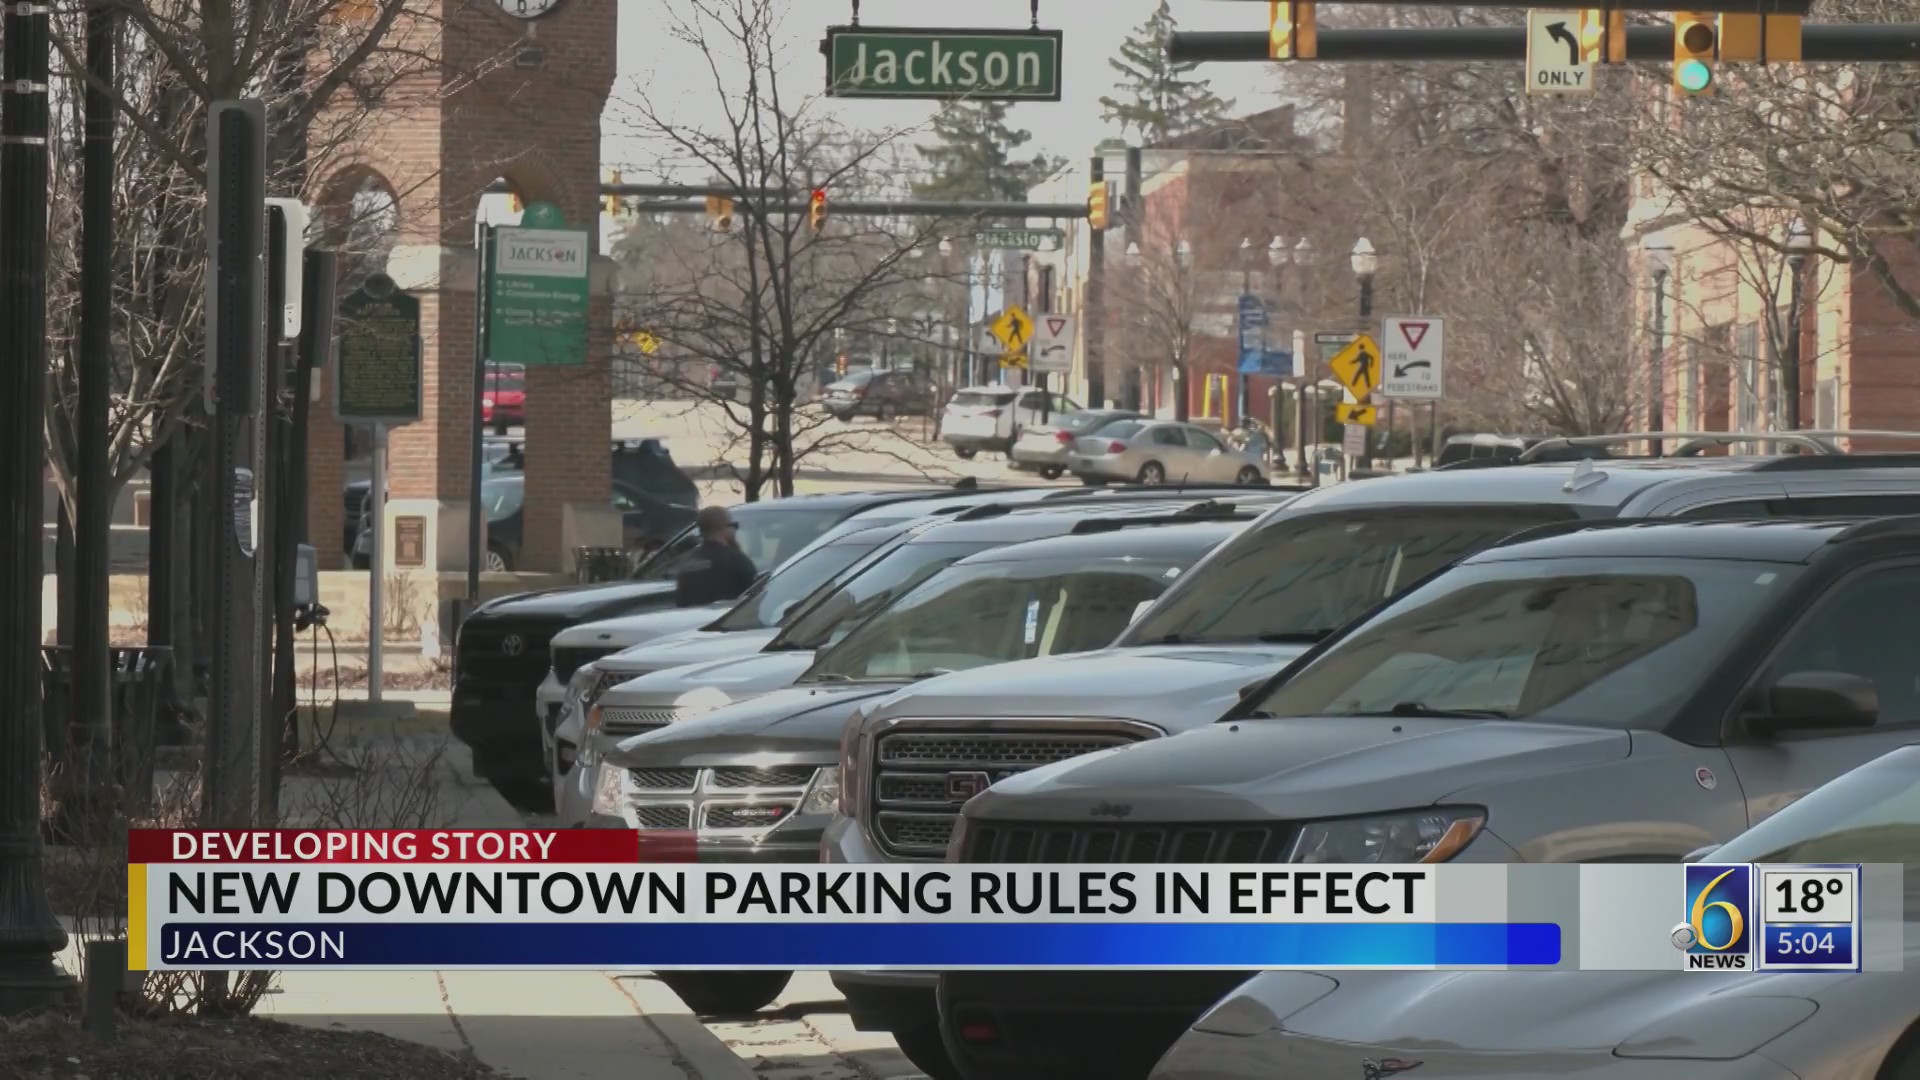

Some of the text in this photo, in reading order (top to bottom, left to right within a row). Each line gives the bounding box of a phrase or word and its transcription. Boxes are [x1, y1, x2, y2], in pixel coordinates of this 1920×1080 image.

[851, 39, 1040, 86] Jackson
[1538, 69, 1585, 86] ONLY
[509, 247, 576, 262] JACKSON
[1386, 383, 1439, 392] PEDESTRIANS
